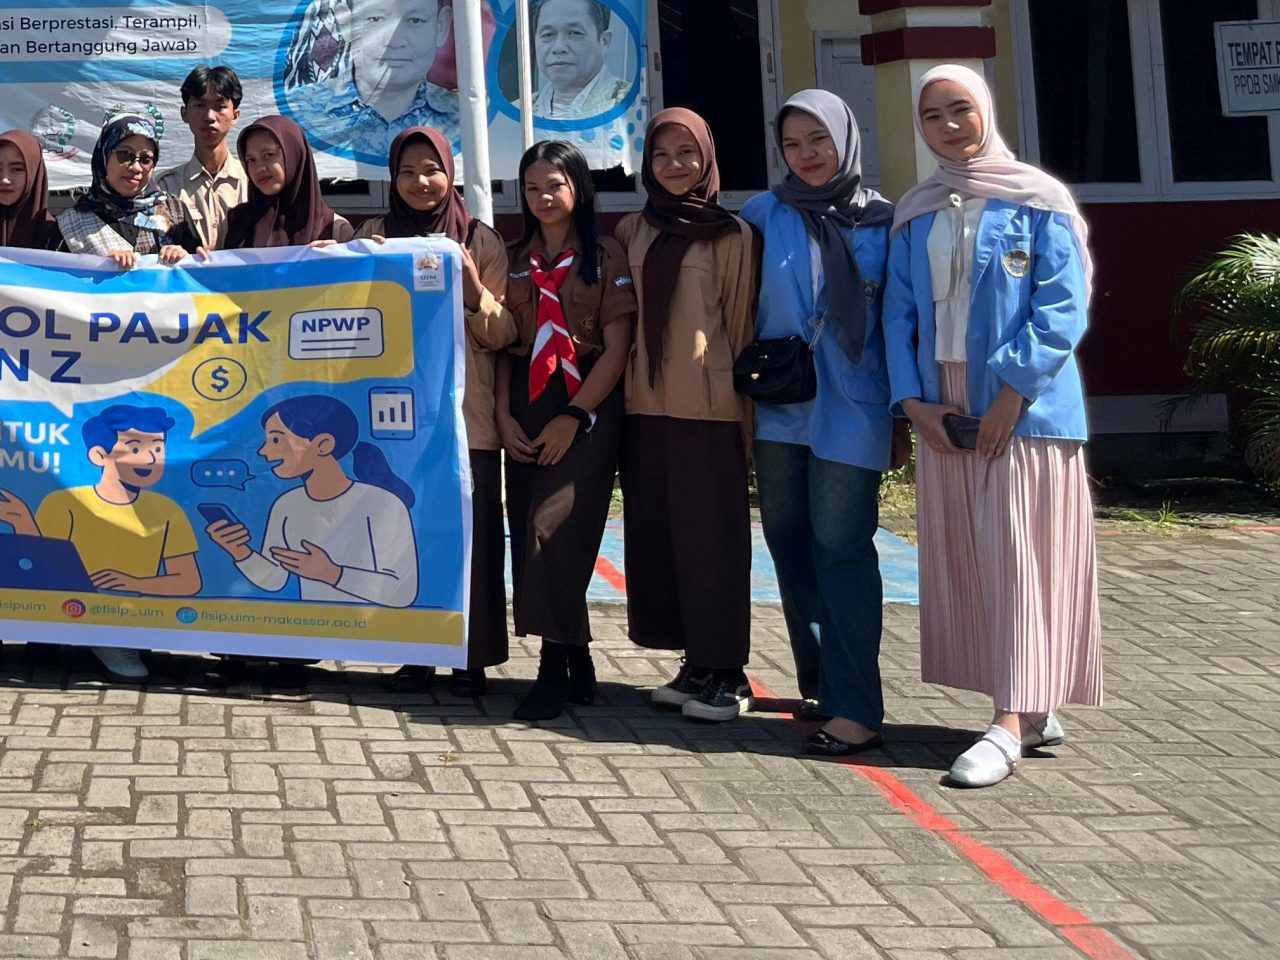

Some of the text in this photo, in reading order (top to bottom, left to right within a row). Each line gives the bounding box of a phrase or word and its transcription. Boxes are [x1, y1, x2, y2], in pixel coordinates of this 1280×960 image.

[122, 15, 202, 31] Terampil,
[26, 39, 138, 57] Bertanggung
[141, 38, 198, 52] Jawab
[1227, 41, 1272, 66] TEMPAT
[1233, 74, 1261, 96] PPDB
[88, 309, 272, 345] PAJAK
[301, 316, 371, 333] NPWP
[50, 350, 82, 384] Z
[89, 604, 164, 617] @fisip_uim
[200, 611, 368, 629] fisip.uim-makassar.ac.id
